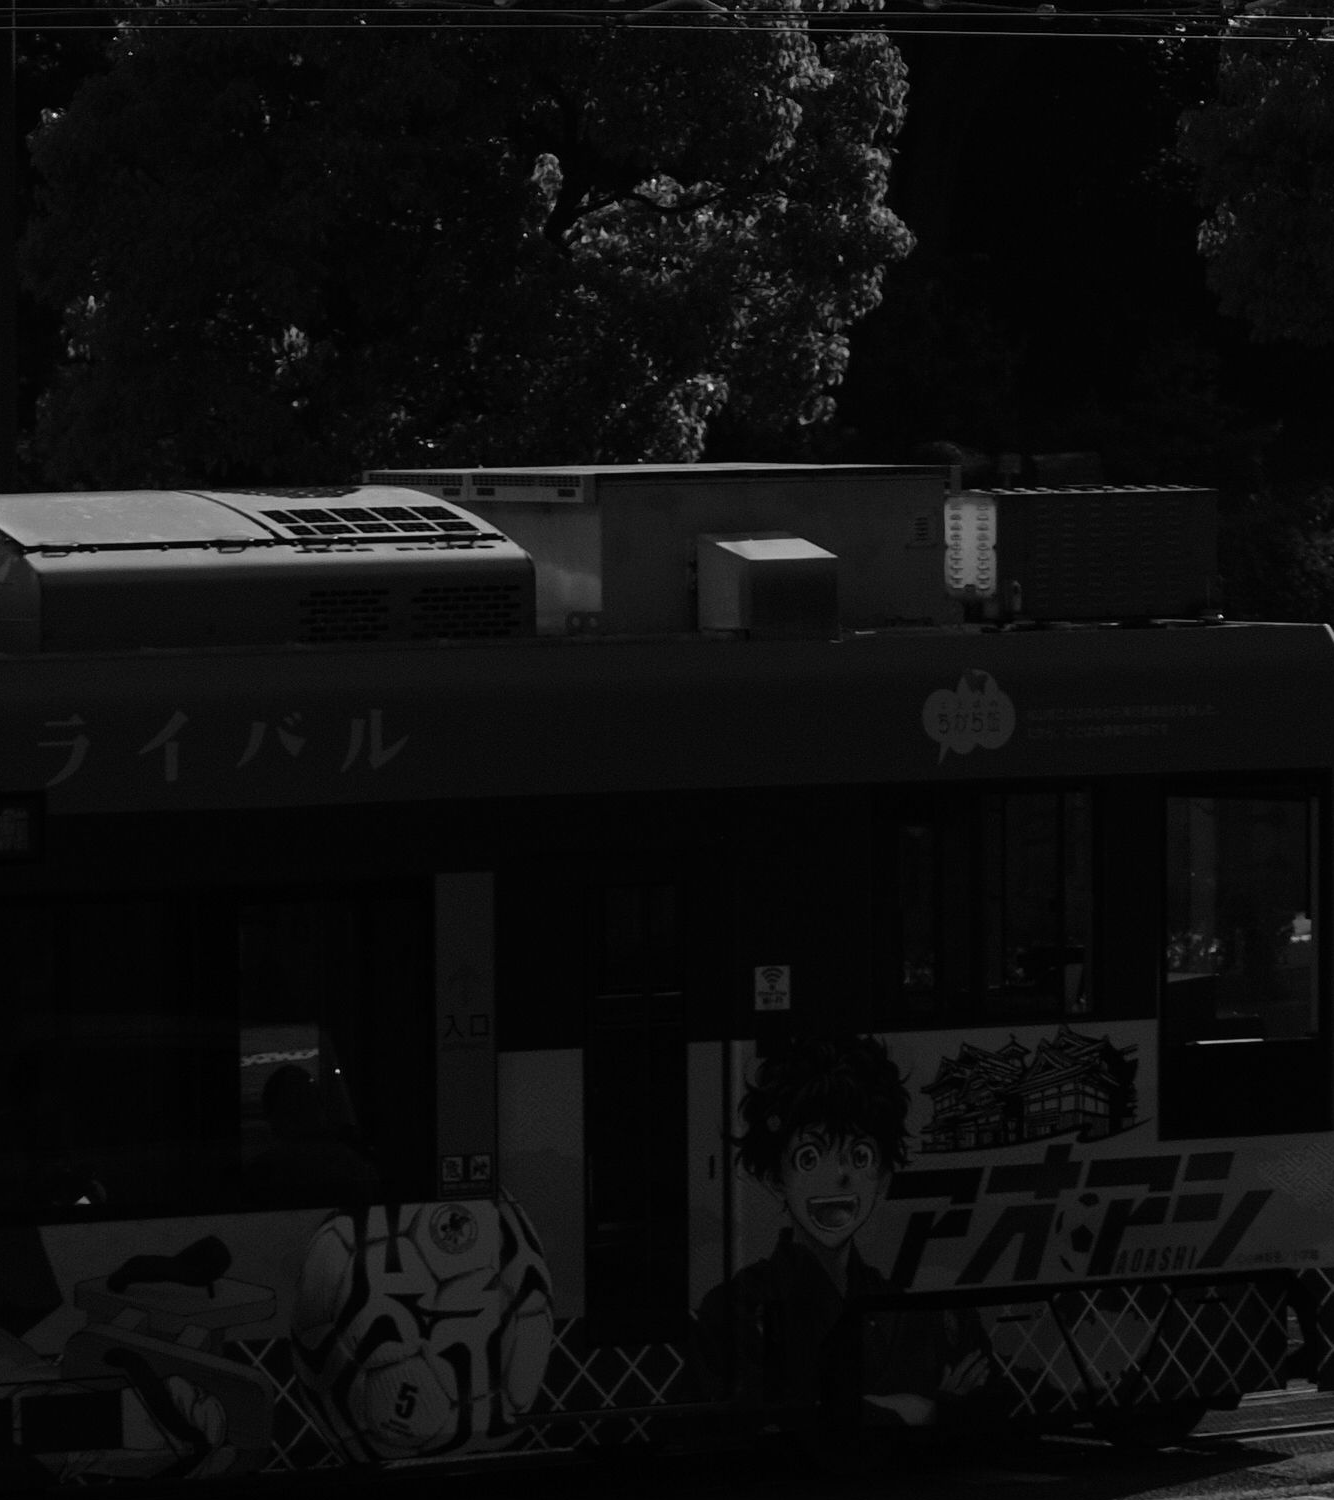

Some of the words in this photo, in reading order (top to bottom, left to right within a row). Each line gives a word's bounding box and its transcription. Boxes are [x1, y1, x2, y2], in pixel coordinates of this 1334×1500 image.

[443, 1013, 489, 1038] 入口
[885, 1143, 1275, 1288] アオアシ
[1116, 1245, 1197, 1274] AOASHI
[395, 1382, 419, 1419] 5
